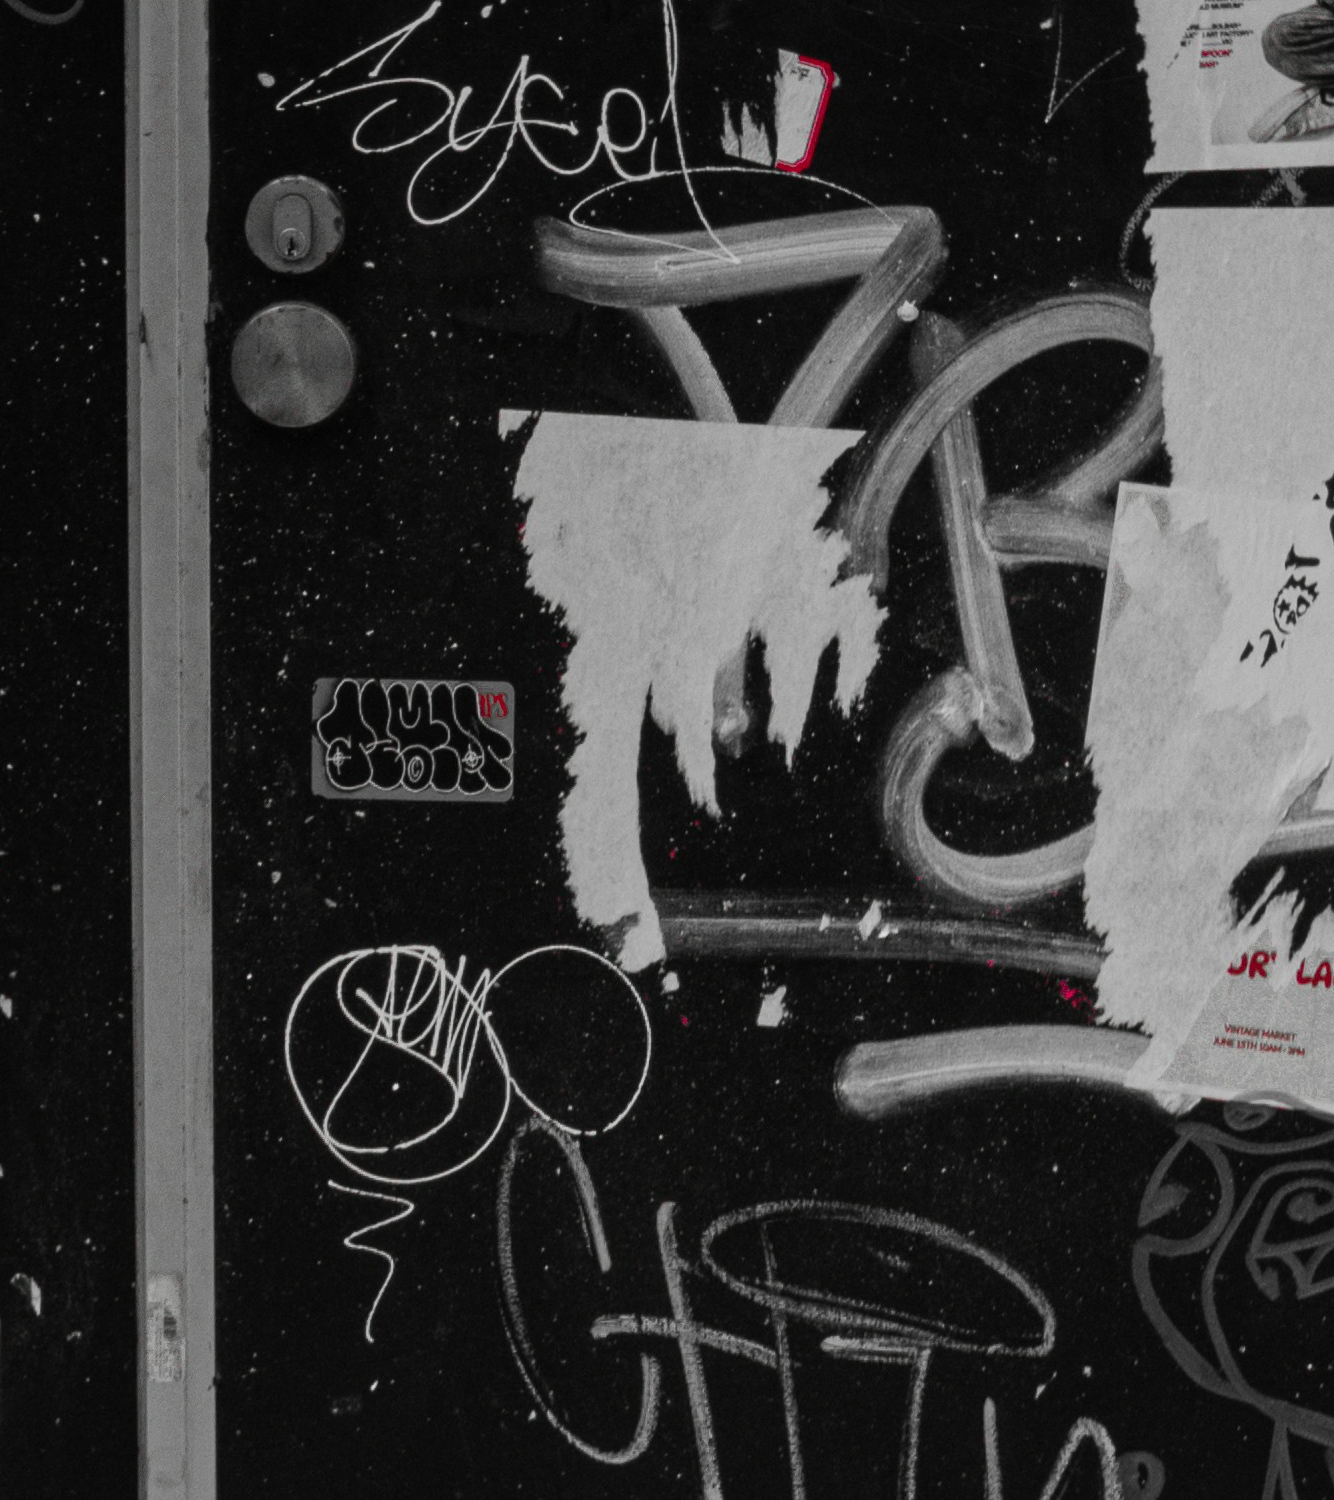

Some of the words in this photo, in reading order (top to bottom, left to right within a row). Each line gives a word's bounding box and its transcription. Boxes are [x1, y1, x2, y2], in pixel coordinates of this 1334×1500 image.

[1224, 1022, 1260, 1038] VINTAGE
[1261, 1026, 1297, 1042] MARKET
[1213, 1035, 1234, 1049] JUNE
